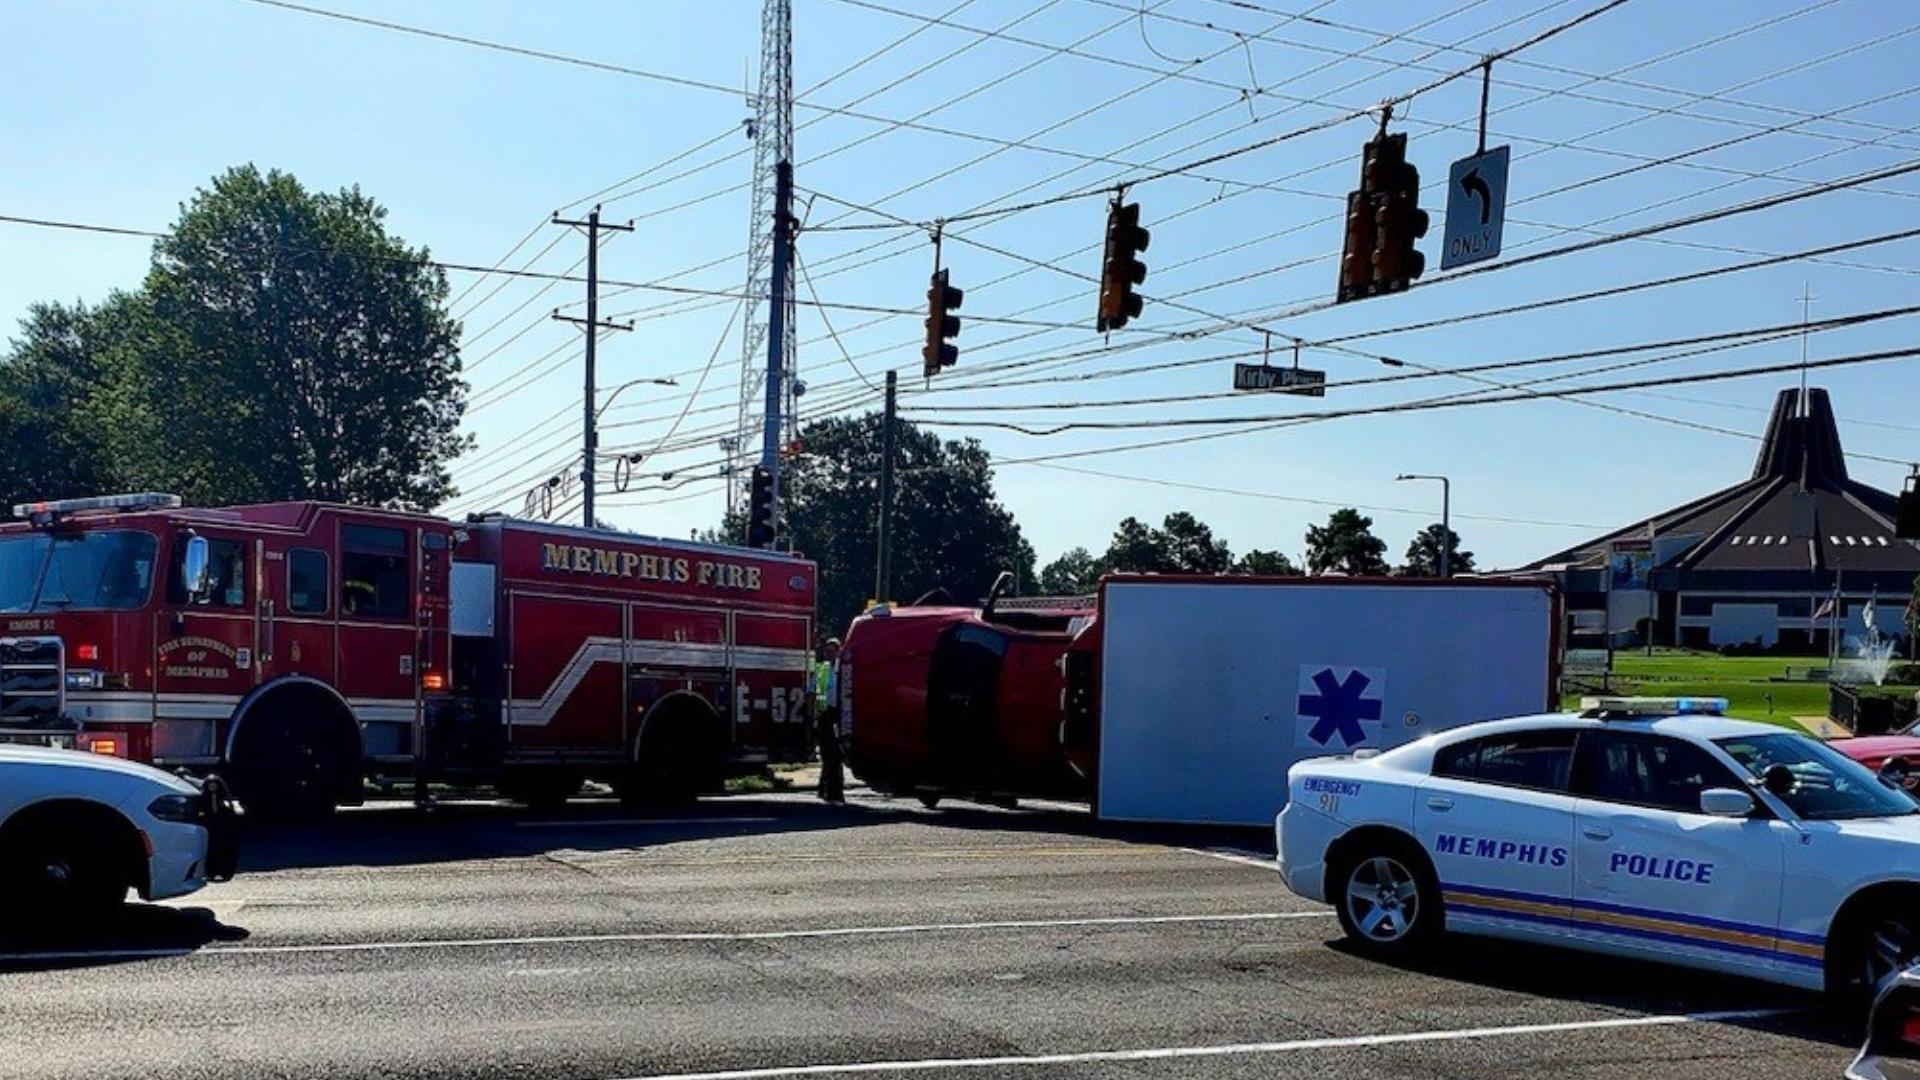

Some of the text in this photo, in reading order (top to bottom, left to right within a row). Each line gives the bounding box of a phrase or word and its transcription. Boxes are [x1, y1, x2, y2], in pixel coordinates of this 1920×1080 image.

[1450, 229, 1492, 258] ONLY
[1237, 366, 1276, 388] Kirby
[542, 543, 762, 590] MEMPHIS FIRE
[187, 651, 207, 662] OF
[165, 665, 230, 679] MEMPHIS
[736, 685, 805, 723] E-52
[1304, 777, 1362, 797] EMERGENCY
[1320, 793, 1340, 813] 911
[1435, 834, 1715, 885] MEMPHIS POLICE
